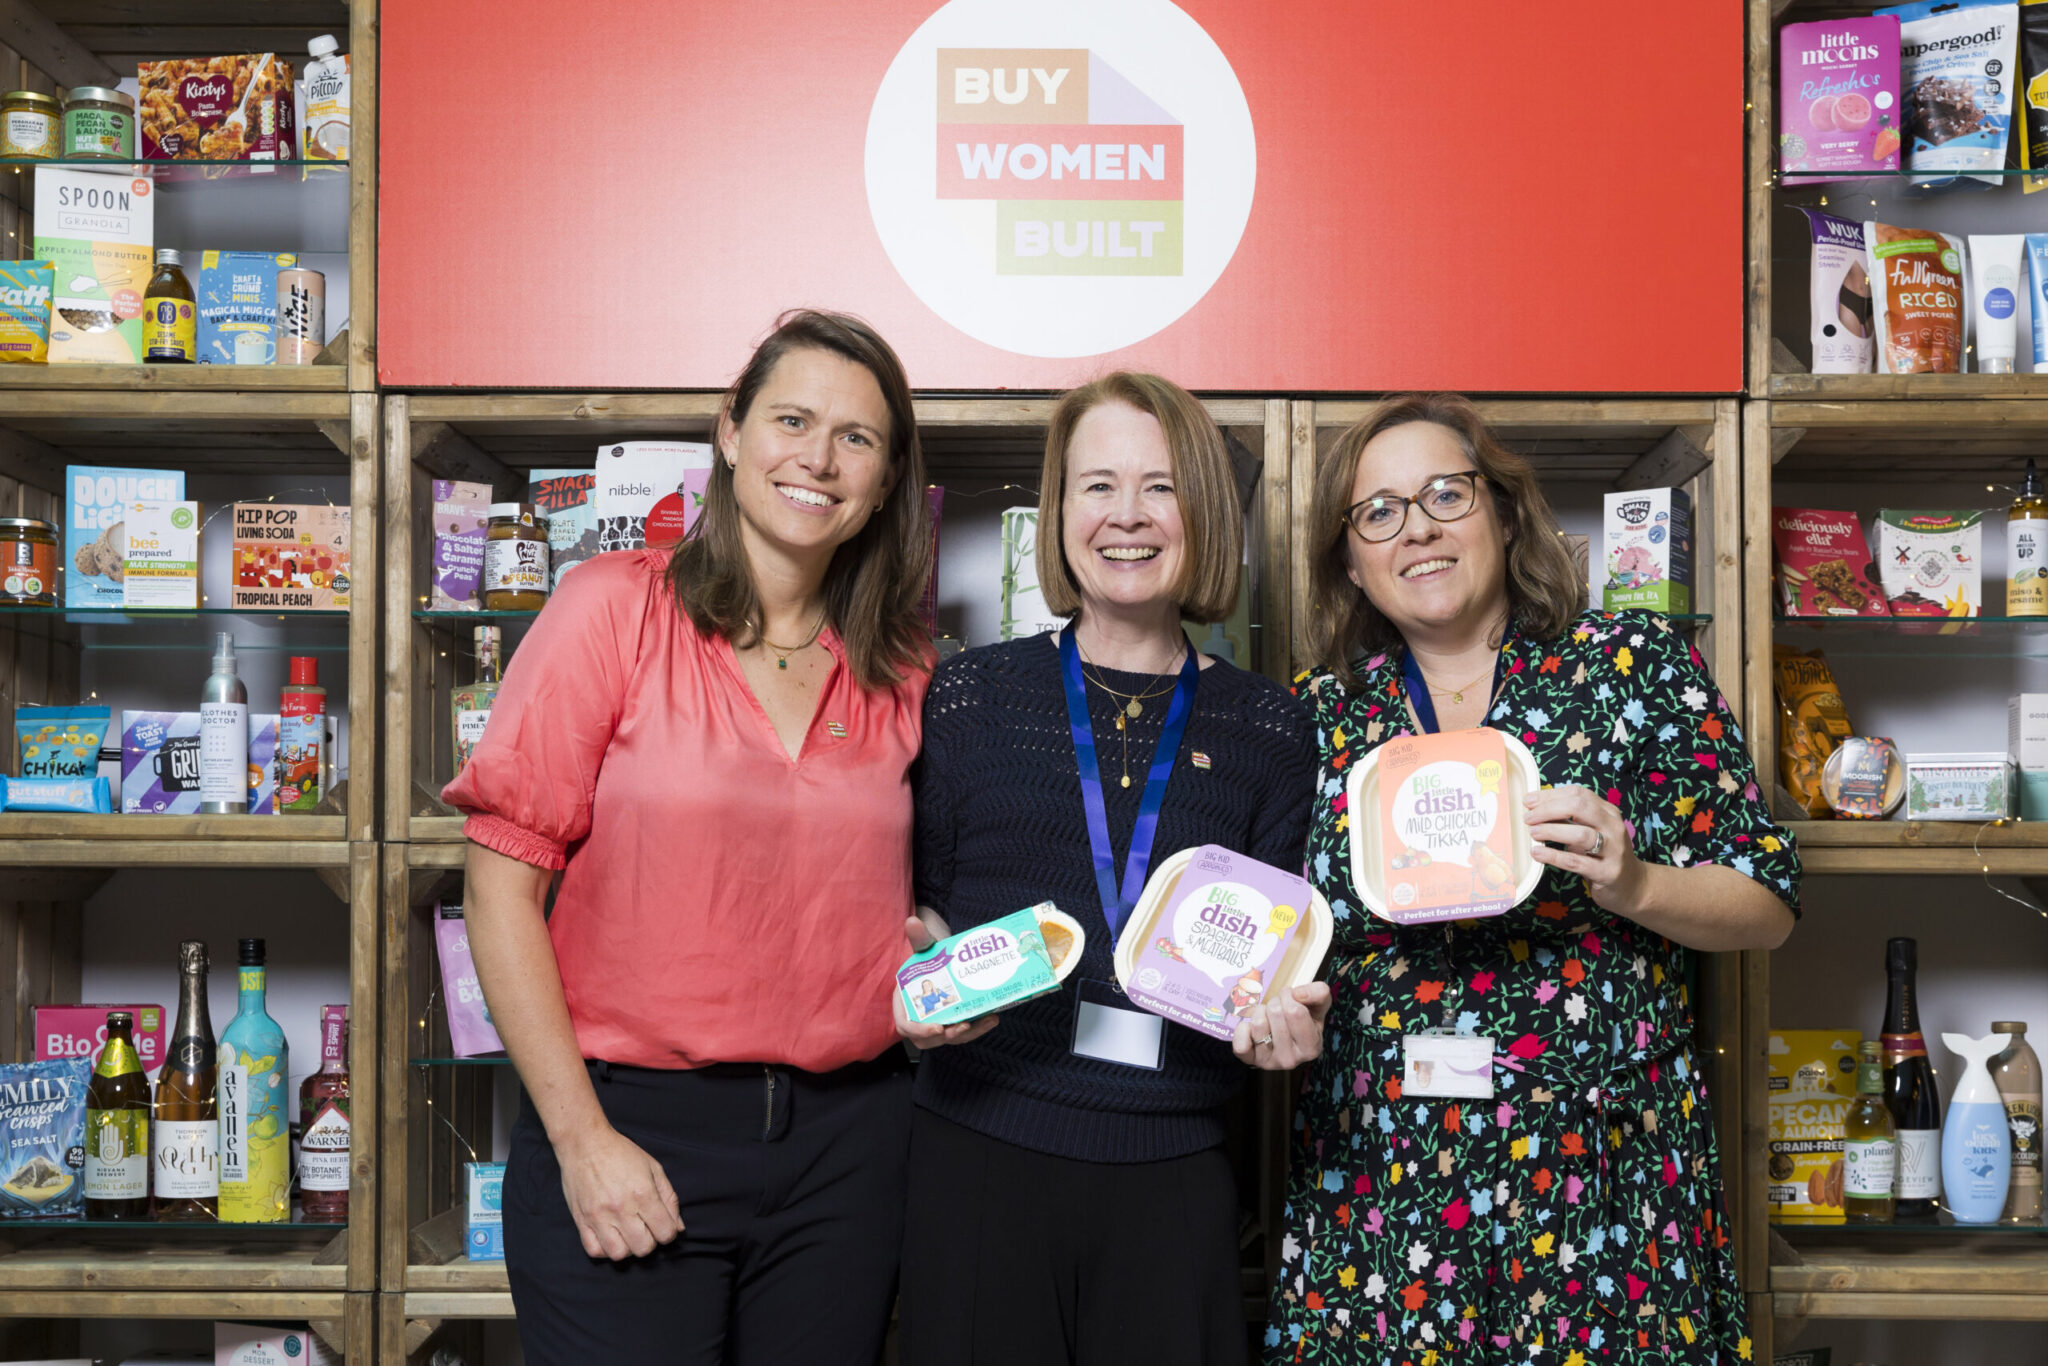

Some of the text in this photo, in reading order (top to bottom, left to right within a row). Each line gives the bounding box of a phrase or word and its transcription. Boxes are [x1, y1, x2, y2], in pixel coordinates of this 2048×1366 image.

[1820, 32, 1860, 49] little
[1801, 43, 1879, 66] moons
[1986, 63, 2001, 72] GF
[954, 67, 1071, 105] BUY
[1985, 84, 2000, 93] PB
[75, 120, 106, 128] PECAN
[75, 127, 122, 138] & ALMOND
[955, 143, 1165, 181] WOMEN
[58, 185, 131, 212] SPOON
[64, 216, 123, 230] GRANOLA
[1014, 220, 1165, 258] BUILT
[1817, 235, 1857, 247] Period-Proof
[38, 246, 148, 261] APPLE ALMOND BUTTER
[232, 282, 261, 293] CRUMB
[232, 293, 260, 304] MINIS
[1899, 291, 1958, 309] RICED
[201, 305, 262, 317] MAGICAL MUG
[1904, 311, 1929, 320] SWEET
[241, 314, 265, 323] CRAFT
[535, 473, 597, 495] SNACK
[608, 483, 651, 497] nibble
[74, 475, 177, 508] DOUGH
[535, 490, 589, 511] ZILLA
[1624, 502, 1650, 513] SMALL
[236, 509, 297, 525] HIP POP
[437, 503, 465, 517] BRAVE
[236, 527, 295, 540] LIVING SODA
[1778, 518, 1853, 538] deliciously
[129, 535, 160, 550] bee
[333, 536, 343, 546] 4
[1805, 533, 1832, 546] ella
[2018, 533, 2034, 543] ALL
[128, 549, 172, 558] prepared
[442, 542, 485, 556] & Salted
[2018, 548, 2034, 559] UP
[442, 552, 483, 567] Caramel
[447, 564, 480, 576] Crunchy
[454, 572, 473, 581] Peas
[509, 573, 544, 585] PEANUT
[2010, 587, 2042, 597] miso &
[236, 593, 312, 607] TROPICAL PEACH
[135, 727, 164, 741] TOAST
[1388, 743, 1413, 756] BIG KID
[1479, 766, 1500, 778] NEW!
[1843, 773, 1883, 781] MOORISH
[33, 785, 66, 797] stuff
[1412, 774, 1442, 796] BIG
[1414, 788, 1476, 816] dish
[1434, 810, 1488, 832] CHICKEN
[1204, 851, 1230, 864] BIG KID
[1206, 885, 1240, 907] BIG
[1272, 909, 1295, 925] NEW!
[1404, 903, 1501, 920] Perfect for after school
[1199, 903, 1259, 941] dish
[969, 935, 990, 946] little
[1190, 920, 1255, 955] SPAGHETTI
[958, 934, 1009, 963] dish
[1185, 933, 1249, 969] & MEATBALLS
[958, 950, 1017, 979] LASAGNETTE
[1138, 995, 1230, 1037] Perfect for after school
[1798, 1069, 1826, 1079] paleo
[0, 1076, 75, 1109] MILY
[11, 1134, 57, 1149] SEA SALT
[1772, 1140, 1844, 1153] GRAIN-FREE
[72, 1147, 83, 1155] 99
[1794, 1155, 1832, 1168] Granola
[113, 1182, 143, 1190] LAGER
[243, 1355, 275, 1365] DESSERT
